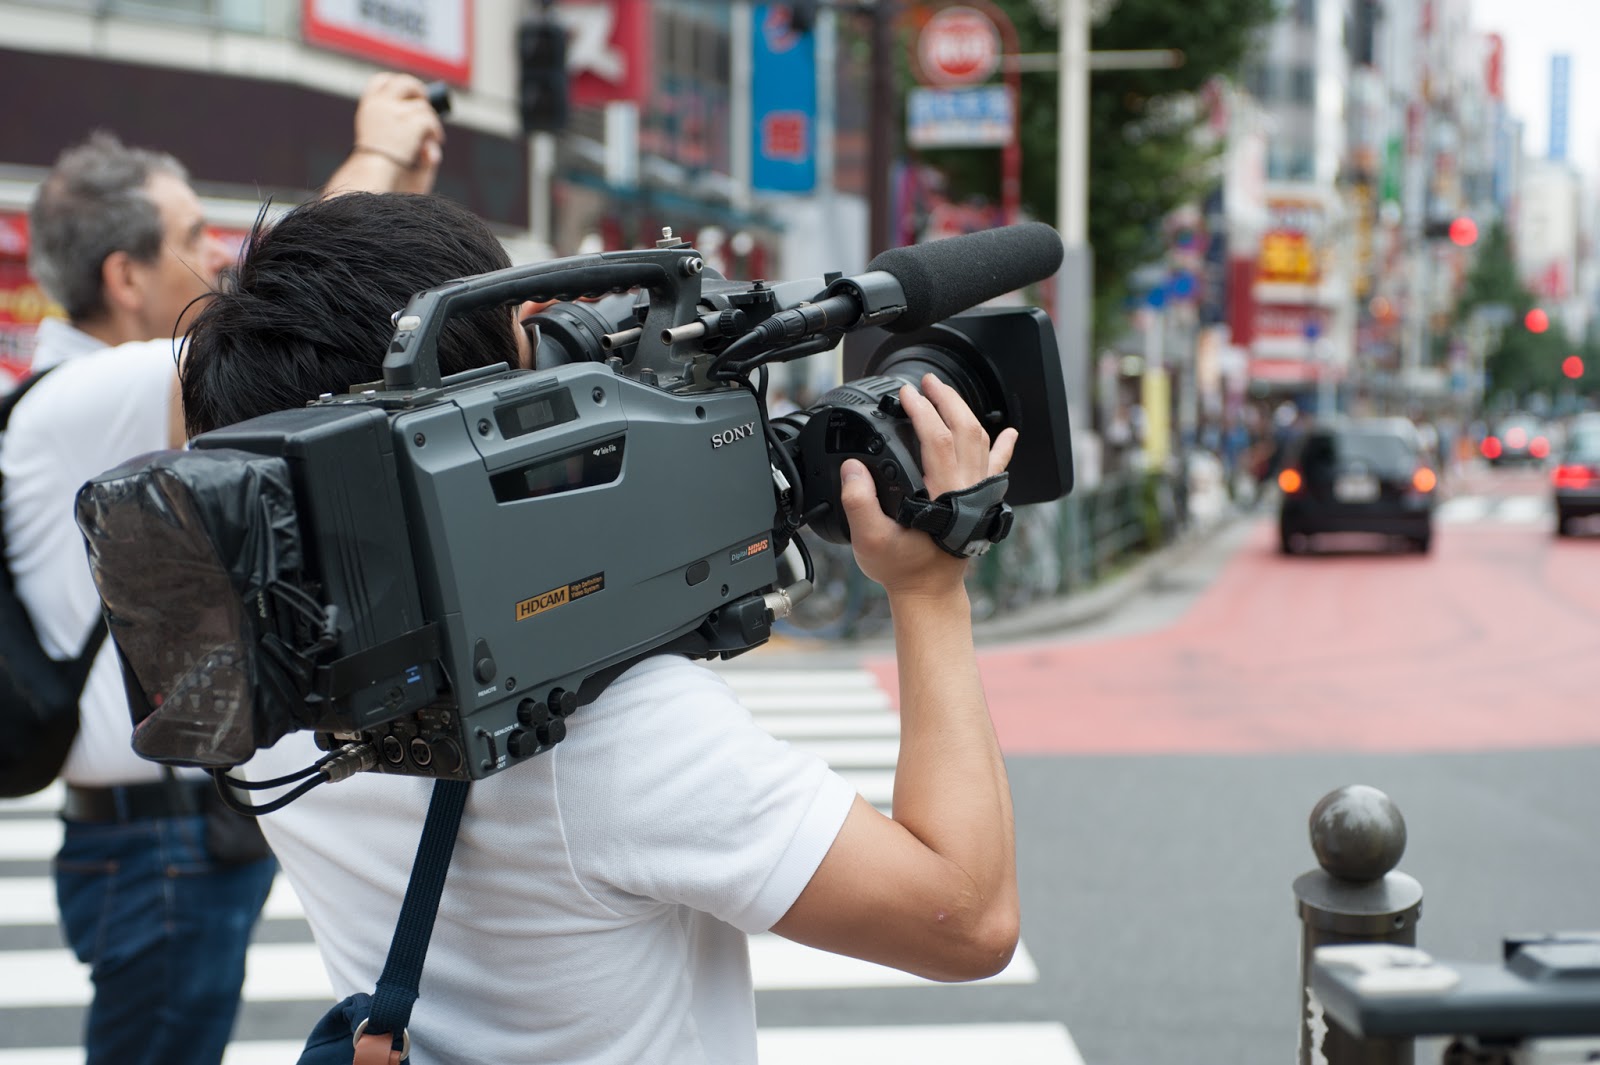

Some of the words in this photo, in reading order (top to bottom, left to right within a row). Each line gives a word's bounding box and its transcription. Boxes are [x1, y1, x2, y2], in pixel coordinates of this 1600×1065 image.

[711, 421, 755, 448] SONY
[731, 550, 748, 561] Digital
[747, 539, 768, 556] HDVS
[571, 584, 581, 592] High
[581, 576, 602, 588] Definition
[520, 590, 565, 616] HDCAM
[571, 590, 583, 598] Video
[477, 686, 497, 697] REMOTE
